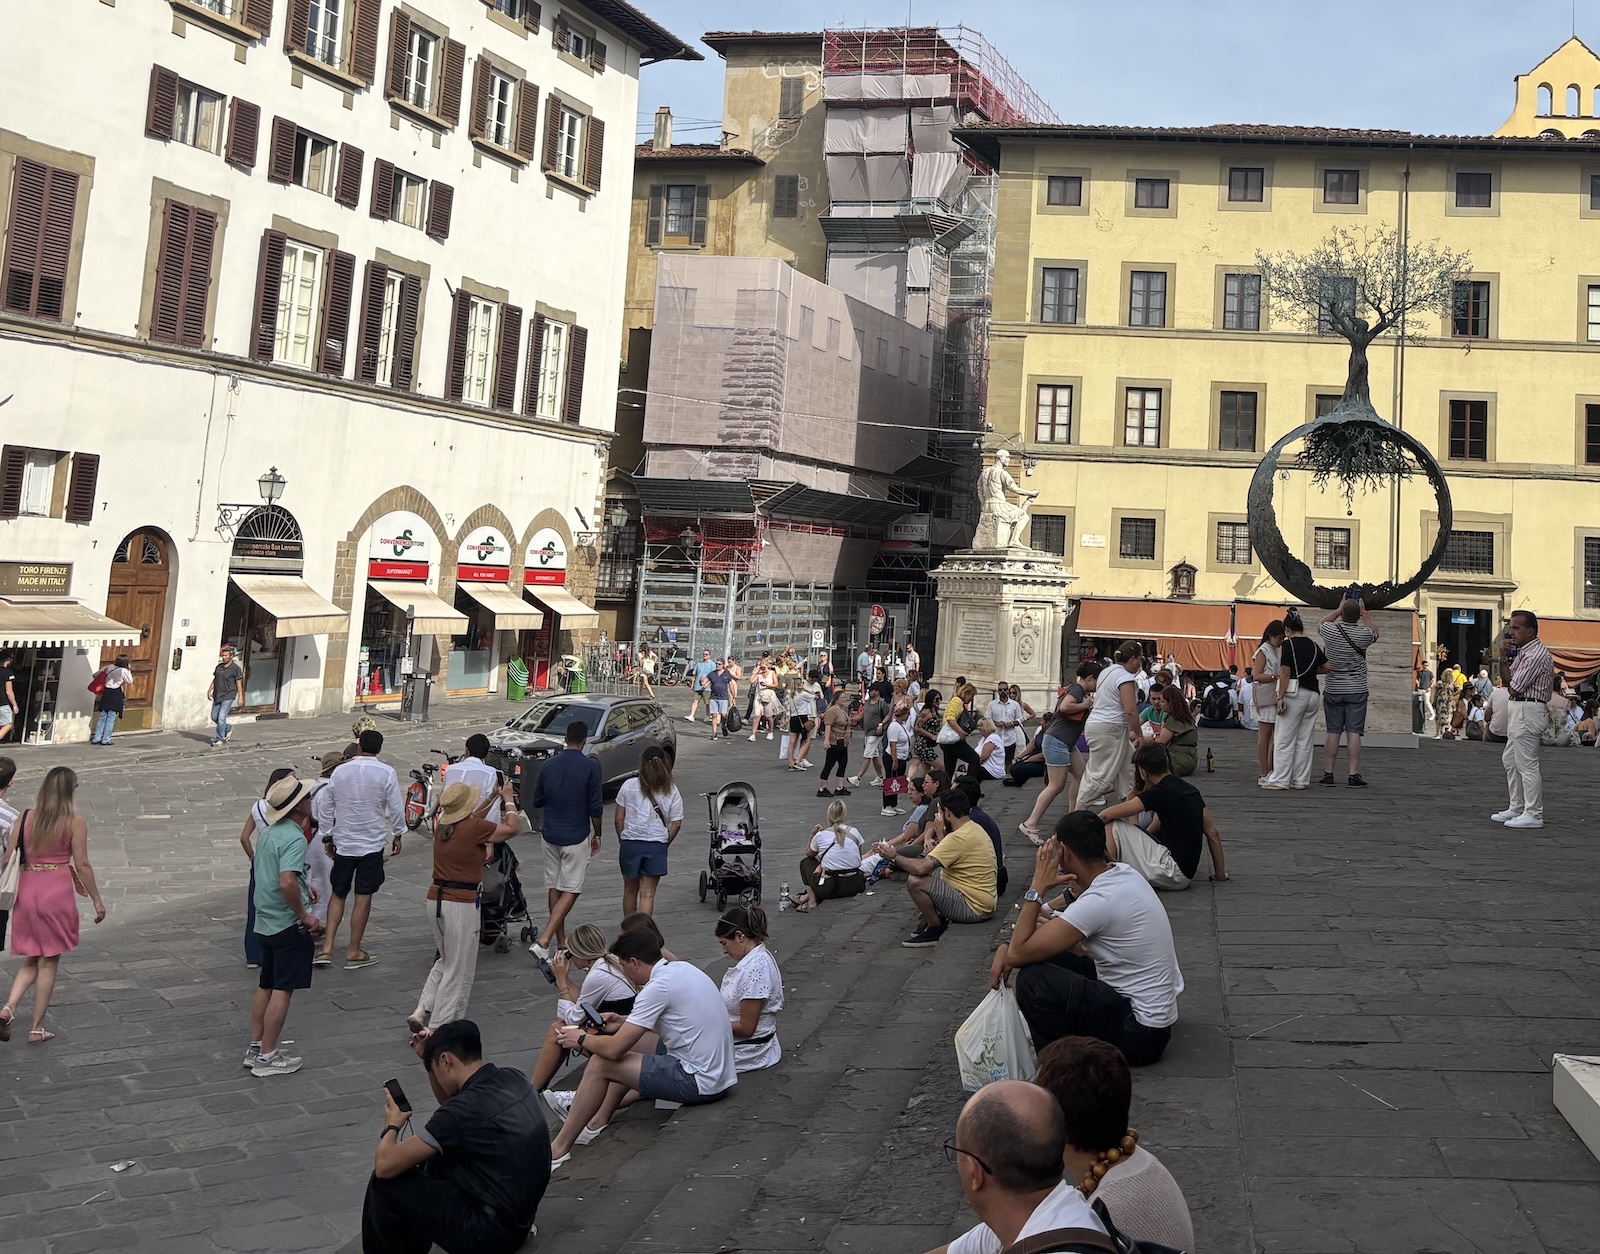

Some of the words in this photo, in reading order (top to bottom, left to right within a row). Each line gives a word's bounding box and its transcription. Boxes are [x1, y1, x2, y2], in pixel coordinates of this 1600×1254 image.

[19, 566, 39, 574] TORO
[40, 566, 68, 575] FIRENZE
[17, 577, 39, 585] MADE
[39, 577, 48, 585] IN
[47, 577, 66, 586] ITALY
